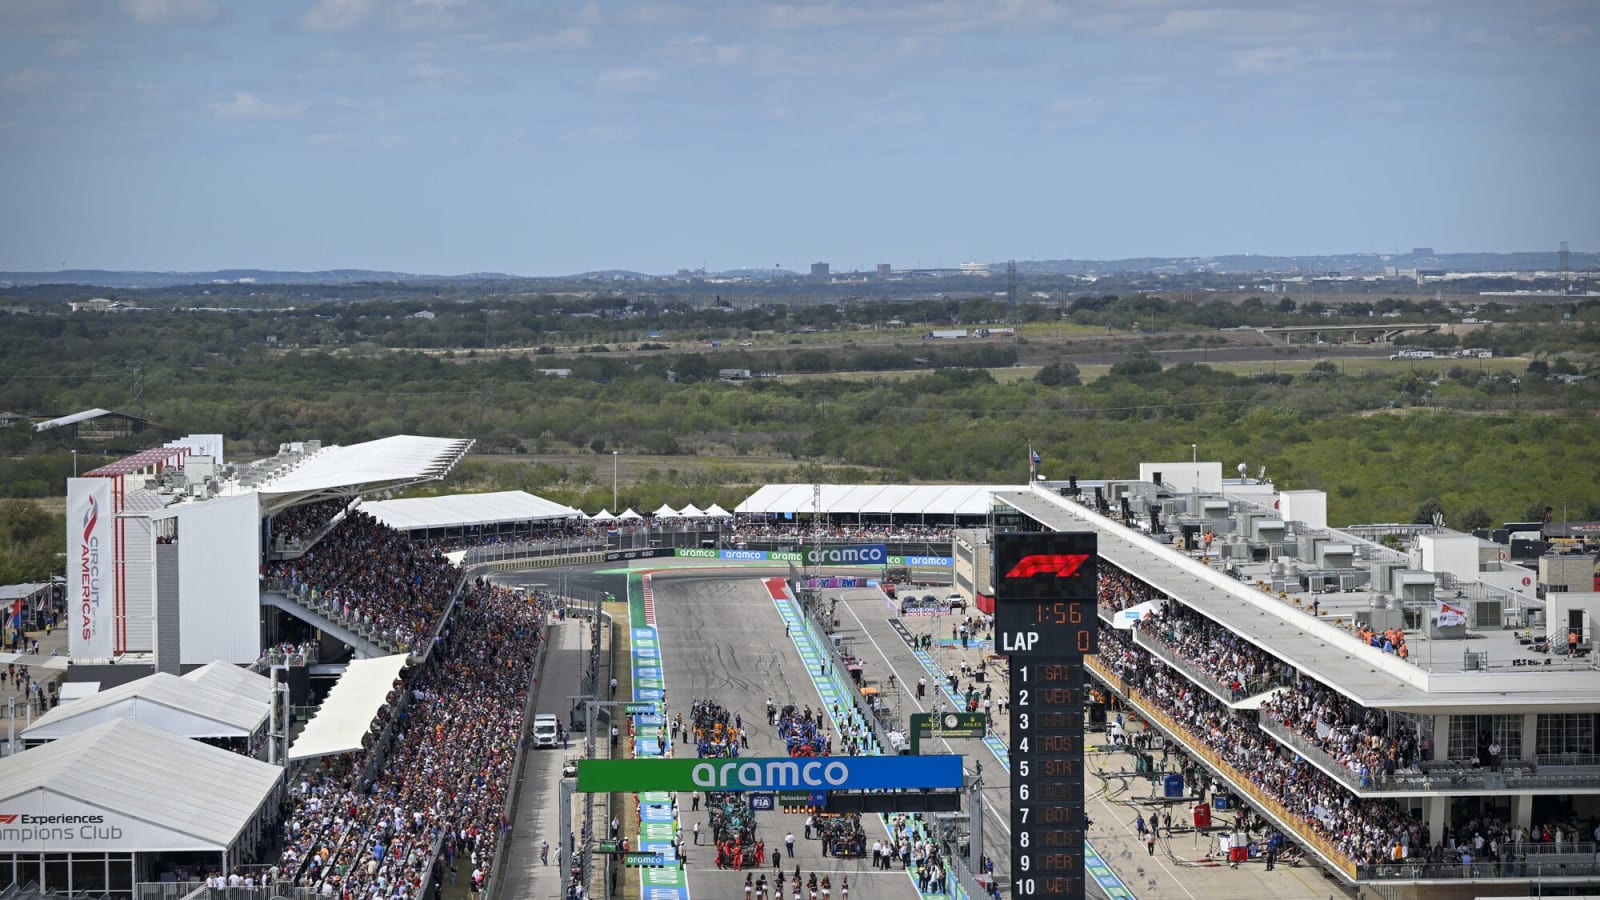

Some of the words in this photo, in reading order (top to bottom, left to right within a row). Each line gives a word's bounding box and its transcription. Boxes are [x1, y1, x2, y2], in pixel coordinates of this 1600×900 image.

[680, 549, 715, 557] aramco
[725, 551, 761, 559] aramco
[808, 548, 881, 562] aramco
[911, 557, 948, 566] aramco
[90, 536, 99, 608] CIRCUIT
[81, 544, 91, 640] AMERICAS
[1037, 602, 1082, 624] 1:56
[1003, 632, 1040, 651] LAP
[1020, 665, 1028, 682] 1
[1019, 689, 1029, 706] 2
[1019, 713, 1029, 730] 3
[1019, 736, 1029, 753] 4
[692, 761, 849, 787] aramco
[1019, 760, 1029, 777] 5
[1020, 784, 1029, 800] 6
[753, 798, 769, 807] FIA
[21, 813, 104, 825] Experiences
[1020, 807, 1029, 824] 7
[80, 825, 122, 840] Club
[1020, 831, 1030, 848] 8
[627, 856, 662, 864] aramco
[1020, 854, 1030, 871] 9
[1015, 878, 1035, 895] 10
